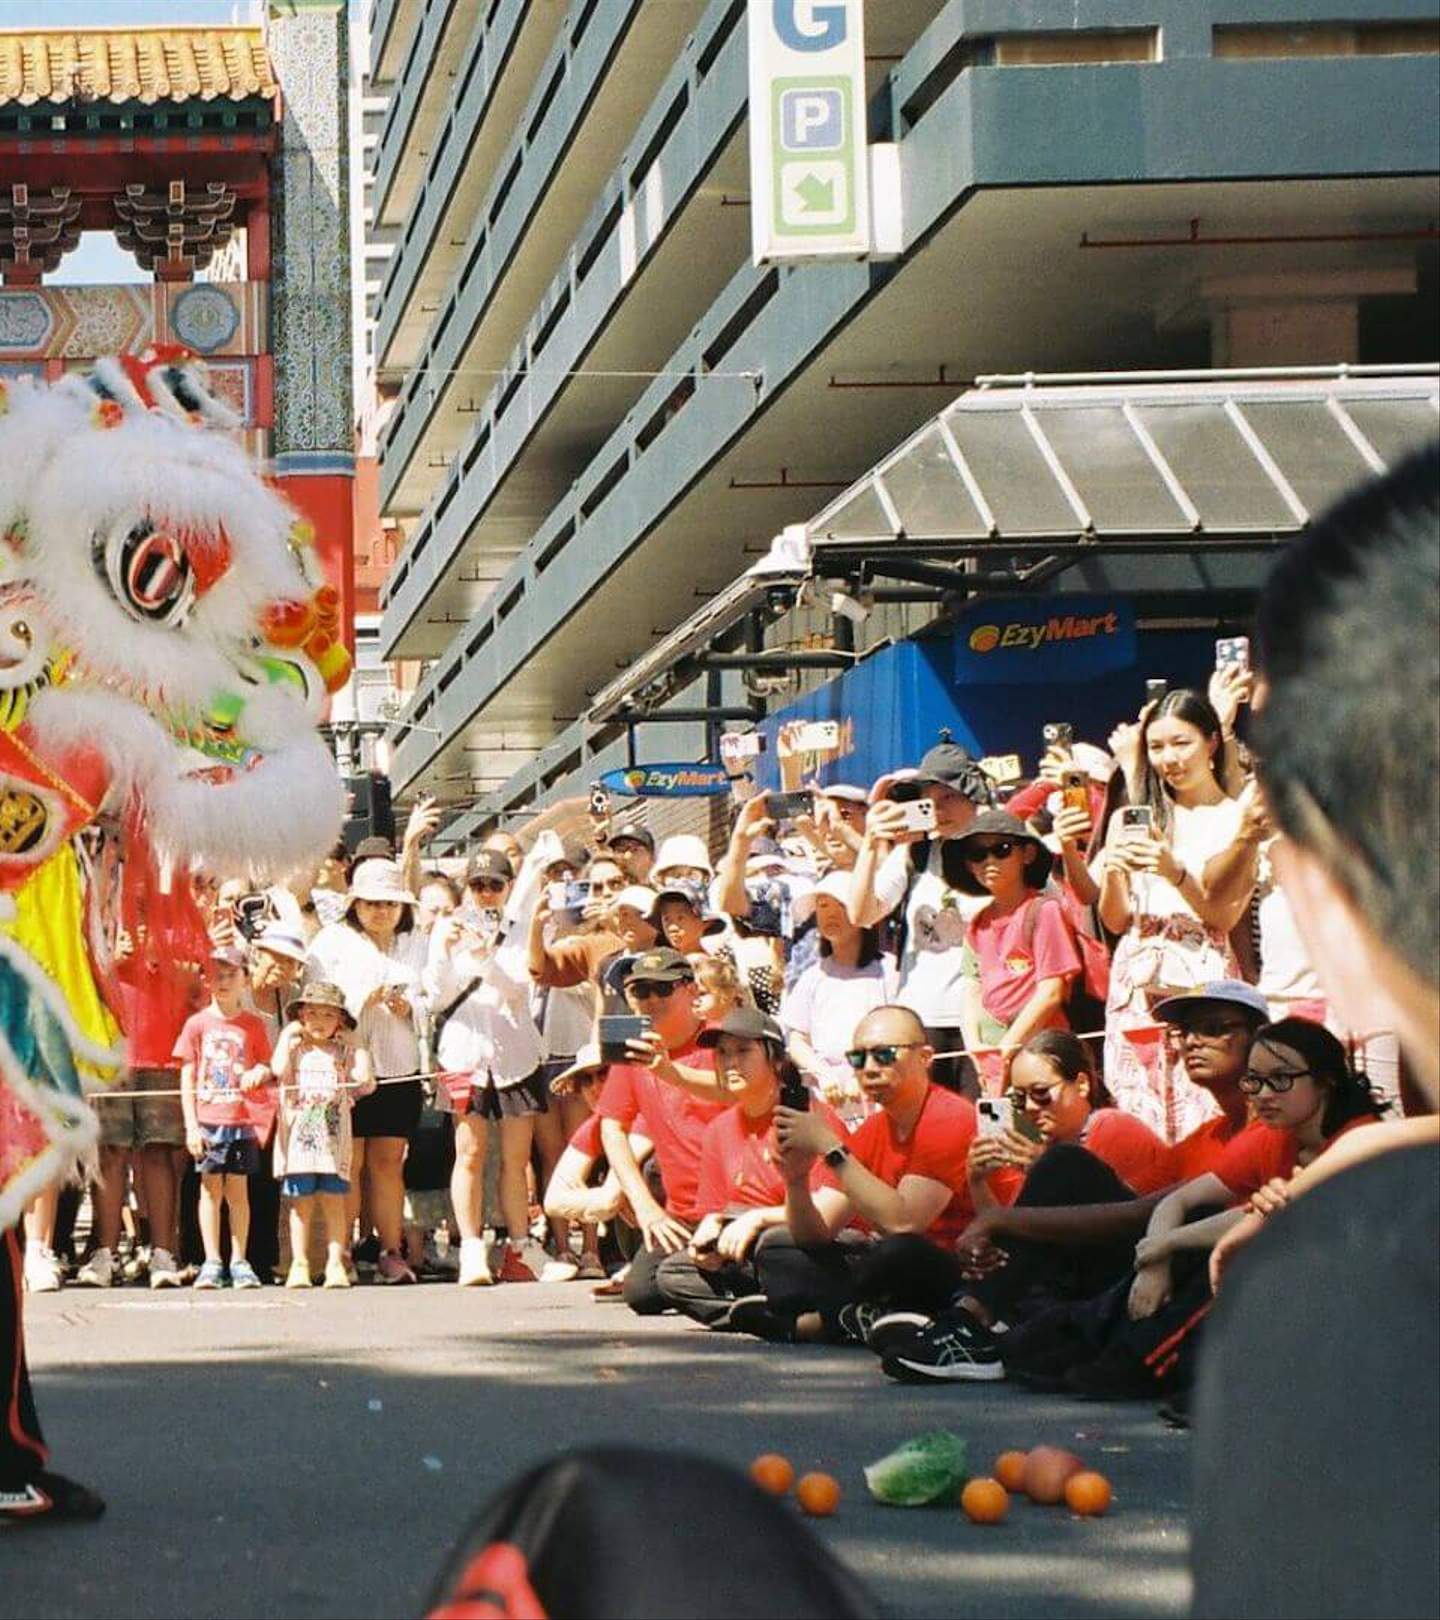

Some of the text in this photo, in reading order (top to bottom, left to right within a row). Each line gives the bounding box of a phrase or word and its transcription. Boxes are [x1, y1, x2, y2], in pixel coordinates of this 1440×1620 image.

[795, 97, 830, 143] P
[1000, 612, 1118, 648] EzyMart
[647, 771, 727, 790] EzyMart
